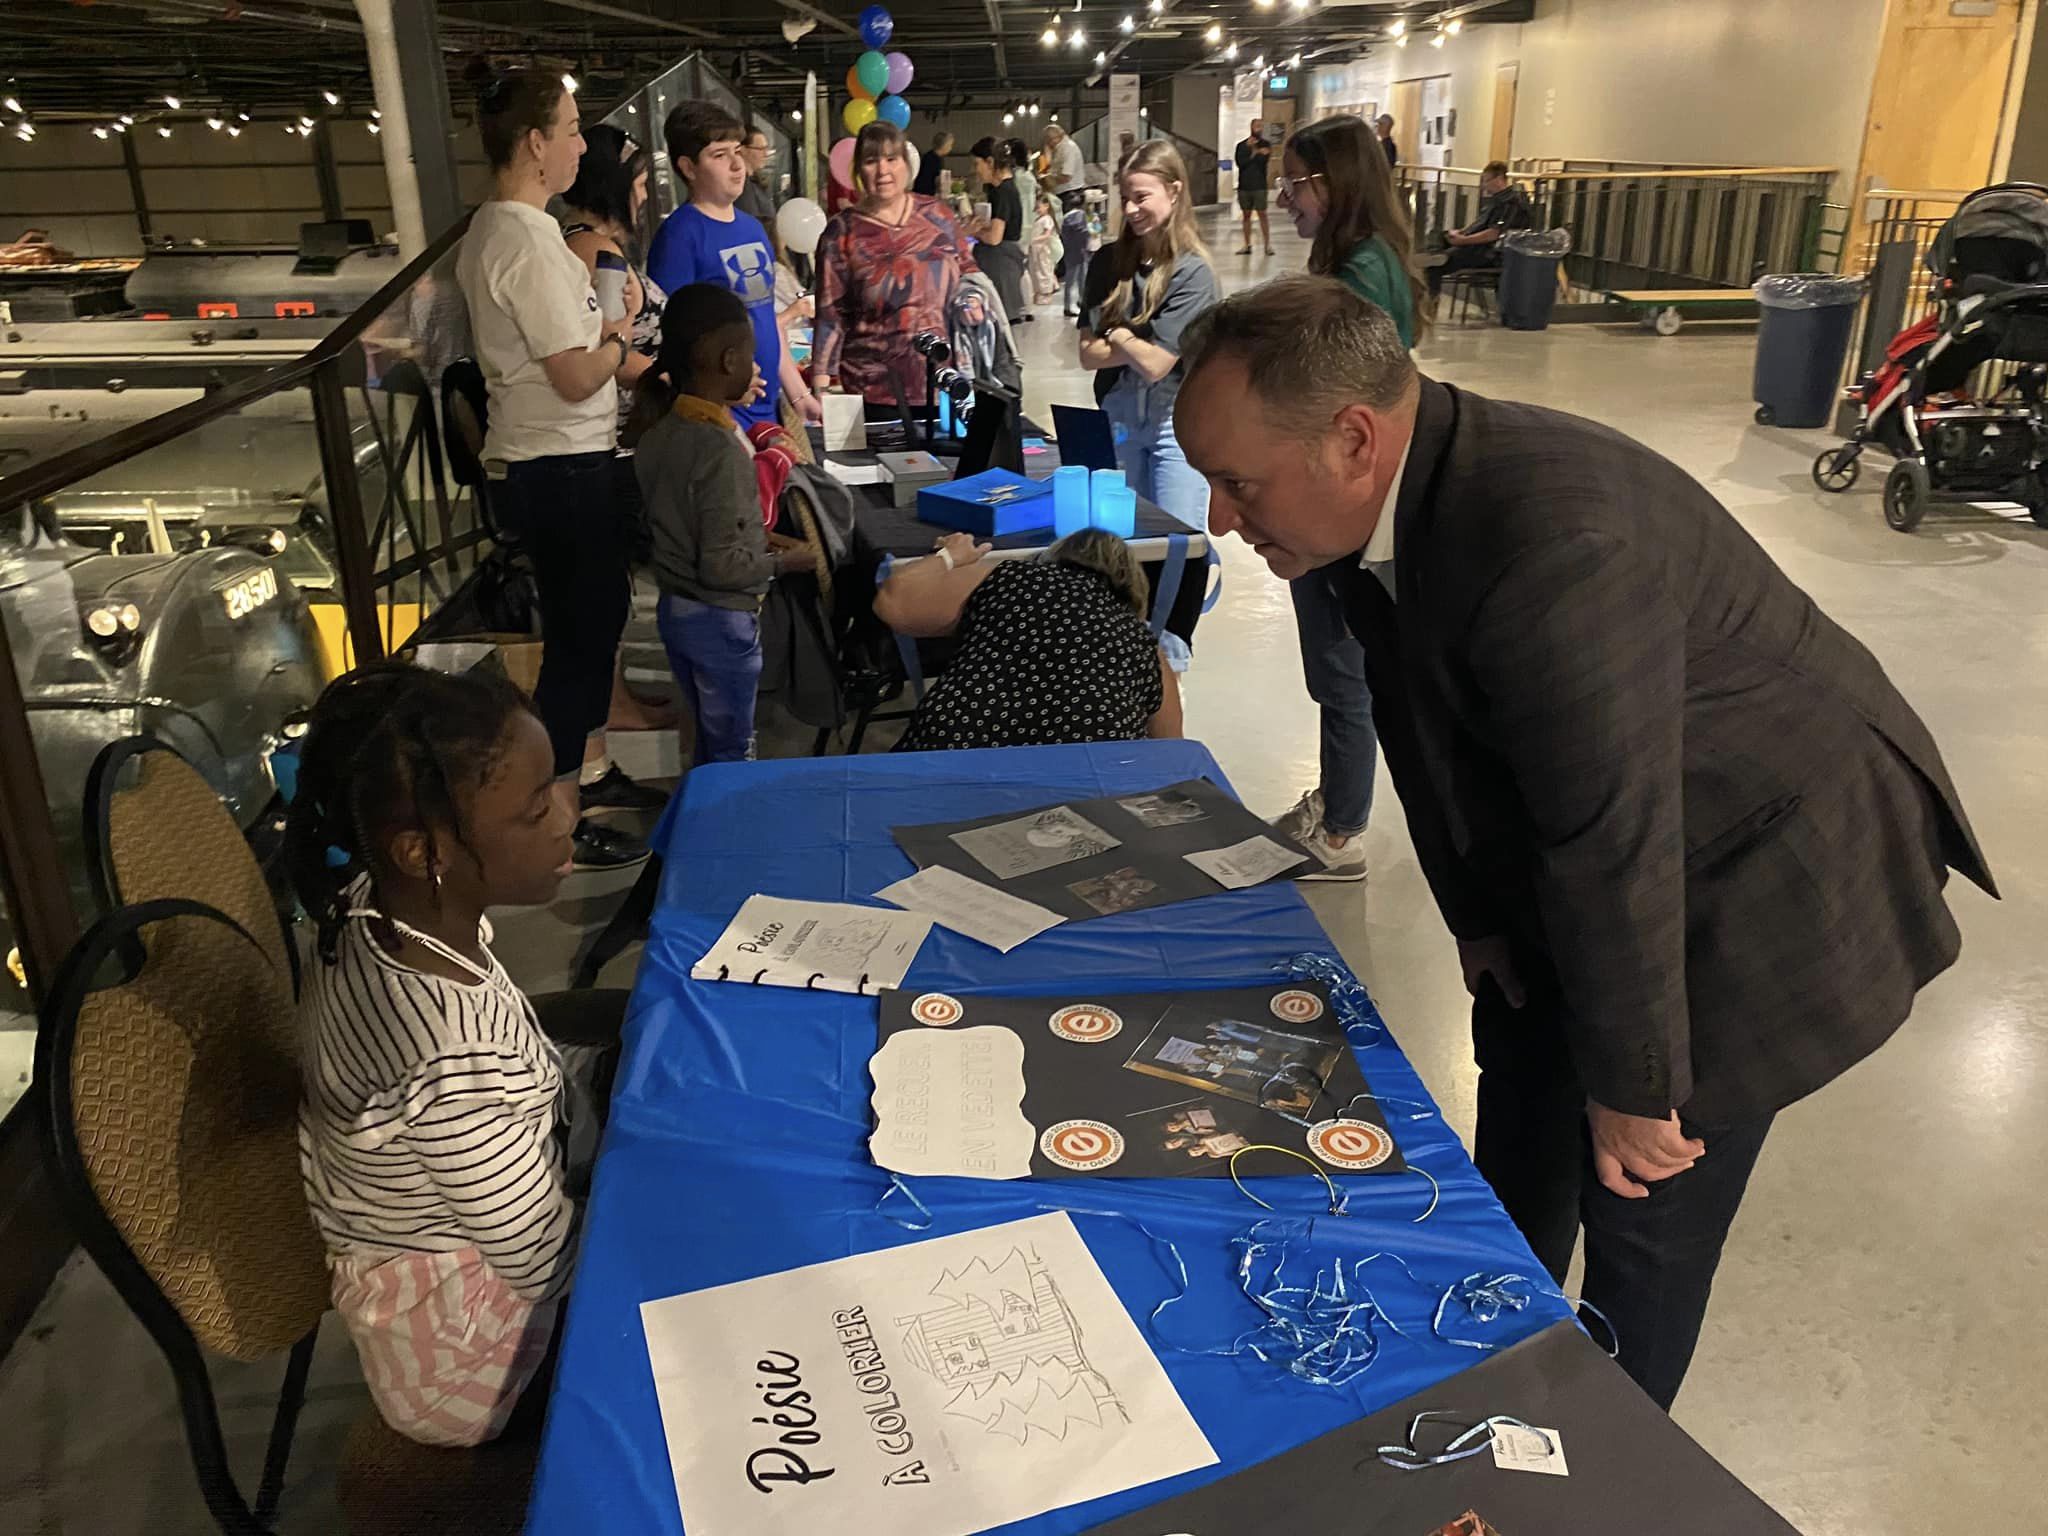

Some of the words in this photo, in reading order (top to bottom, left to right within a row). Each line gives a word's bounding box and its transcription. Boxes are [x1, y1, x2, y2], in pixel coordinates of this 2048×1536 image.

[961, 1137, 997, 1172] EN
[746, 1350, 835, 1493] Poésie
[831, 1305, 914, 1455] COLORIER
[882, 1460, 930, 1487] À
